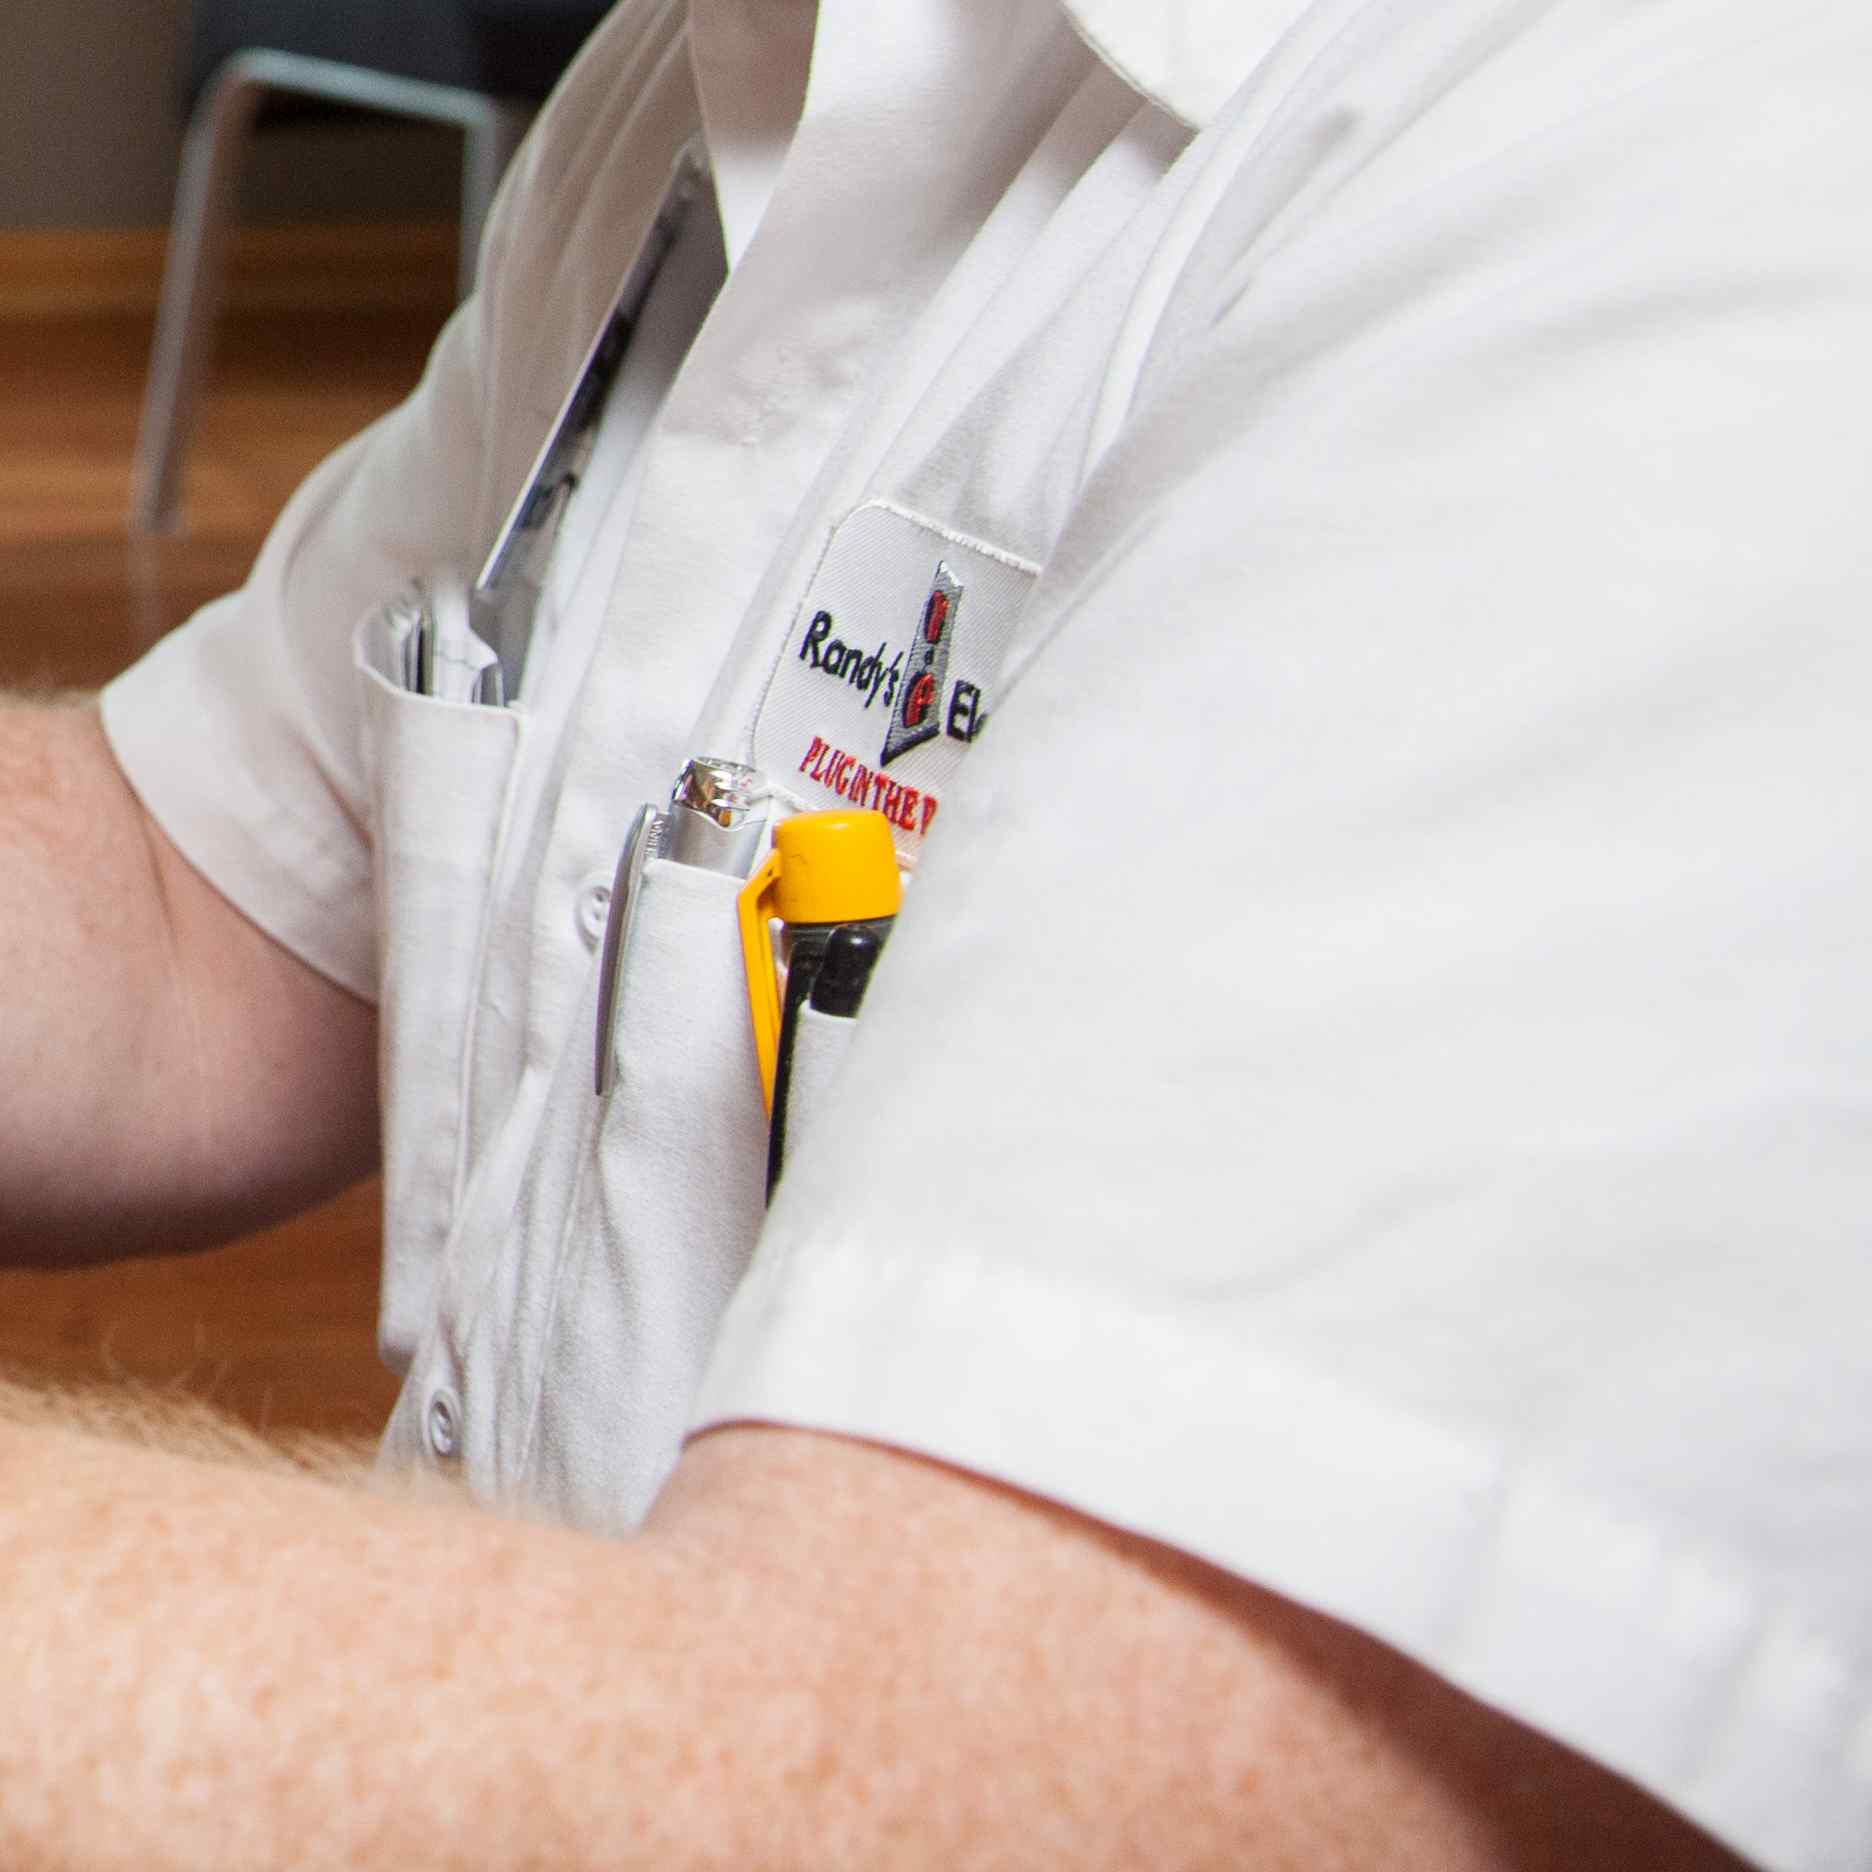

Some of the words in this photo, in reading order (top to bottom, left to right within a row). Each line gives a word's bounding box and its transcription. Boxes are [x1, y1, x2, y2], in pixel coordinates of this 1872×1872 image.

[800, 610, 904, 709] Randy's
[799, 736, 856, 796] PLUG
[871, 771, 920, 831] THE
